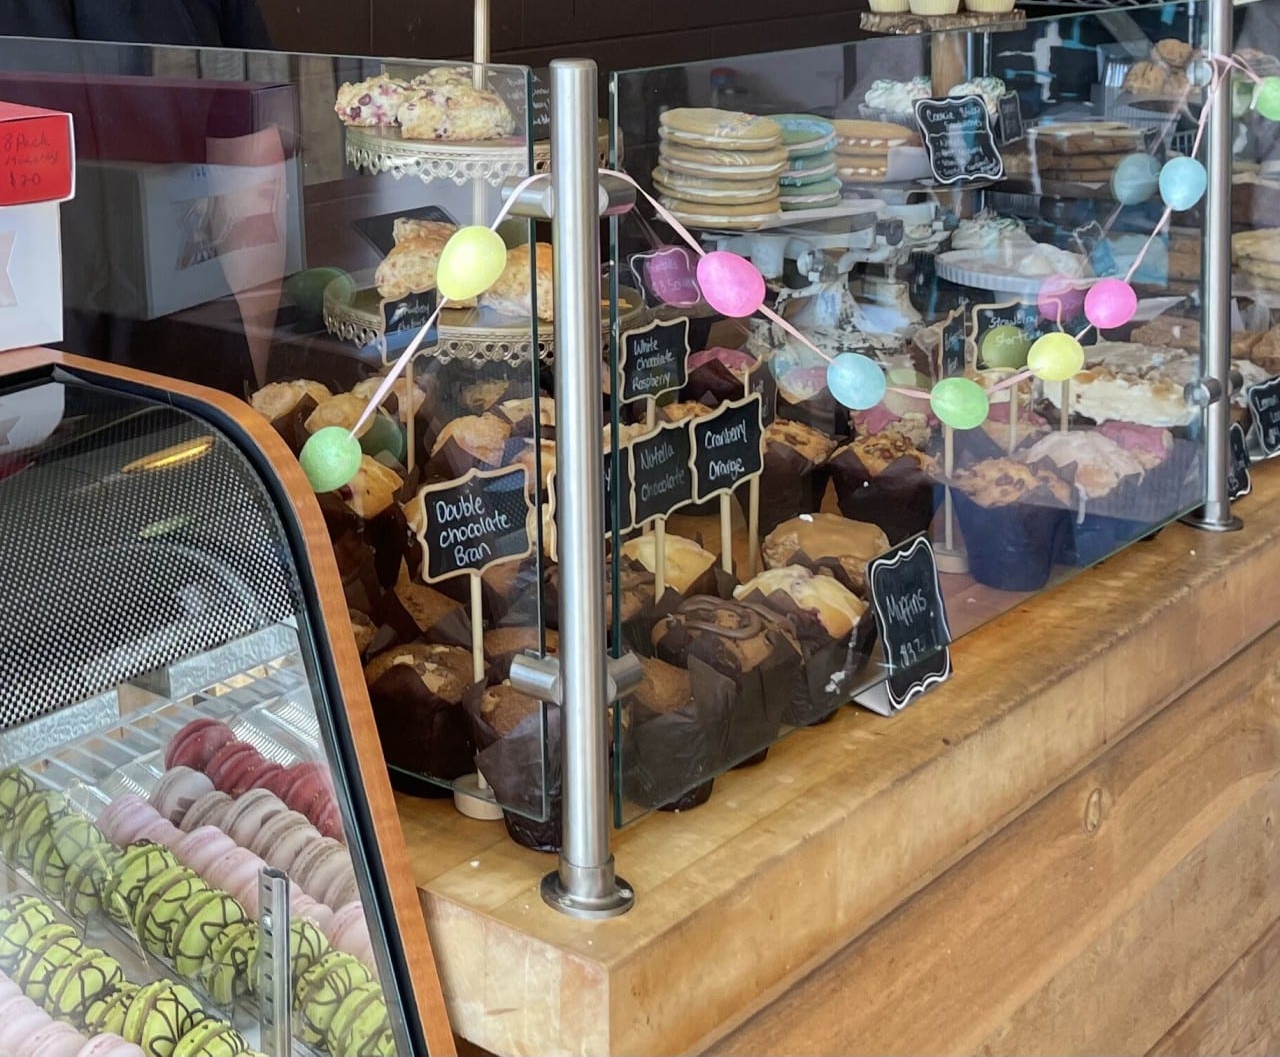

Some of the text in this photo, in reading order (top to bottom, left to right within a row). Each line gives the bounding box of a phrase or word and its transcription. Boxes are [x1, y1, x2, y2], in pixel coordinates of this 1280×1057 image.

[3, 132, 13, 152] 8
[633, 338, 659, 357] White
[631, 371, 672, 392] Raspberry
[704, 418, 749, 450] Cranberry
[639, 441, 676, 471] Nutella
[707, 456, 746, 481] Orange
[435, 494, 486, 524] Double
[439, 509, 512, 549] chocolate
[453, 542, 493, 568] Bran
[885, 587, 928, 627] Muffins
